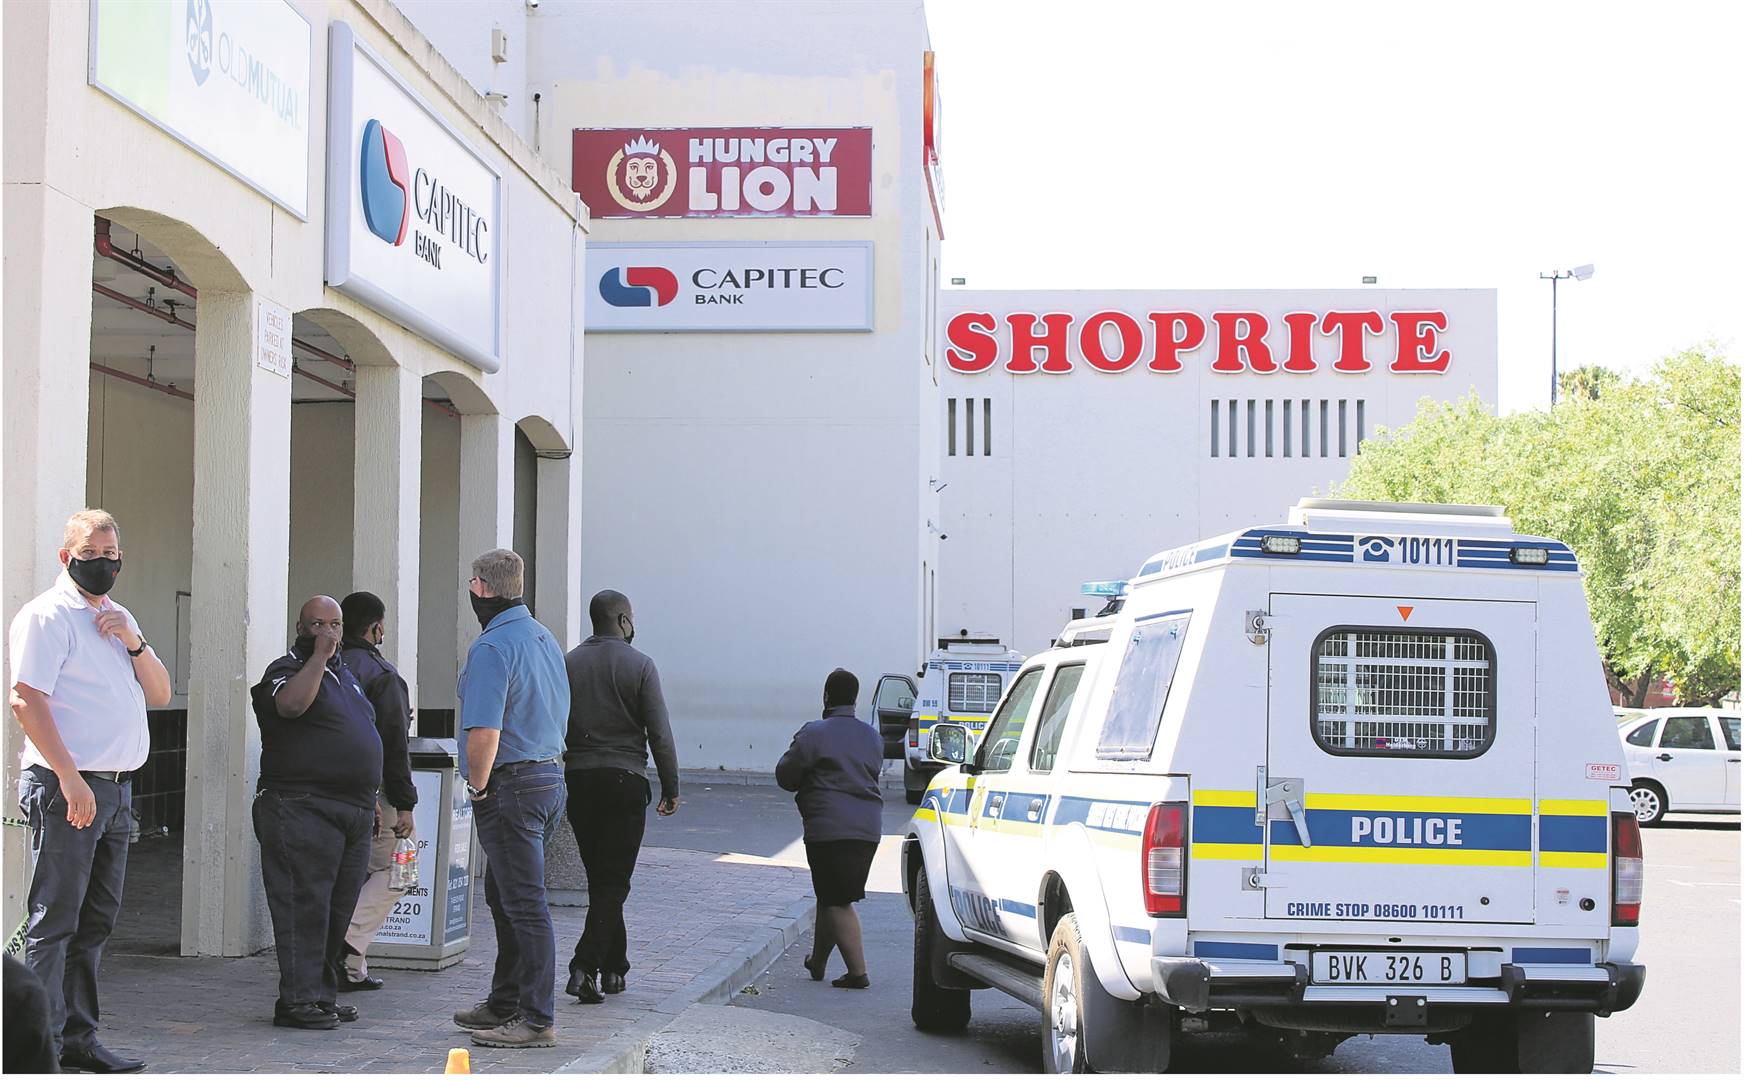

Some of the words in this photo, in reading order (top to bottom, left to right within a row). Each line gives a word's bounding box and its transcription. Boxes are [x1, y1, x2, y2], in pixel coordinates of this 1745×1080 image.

[688, 138, 838, 163] HUNGRY
[688, 166, 838, 211] LION
[414, 167, 488, 264] CAPITEC
[415, 229, 441, 270] BANK
[692, 267, 844, 289] CAPITEC
[694, 294, 744, 304] BANK
[945, 310, 1453, 374] SHOPRITE
[1163, 547, 1195, 571] POLICE
[1399, 537, 1454, 565] 10111
[959, 721, 987, 730] POLIC
[1351, 816, 1463, 845] POLICE
[418, 840, 429, 849] OF
[404, 887, 429, 897] MENTS
[386, 916, 411, 924] TRAND
[954, 889, 1007, 938] POLICE
[1287, 902, 1331, 916] CRIME
[1335, 903, 1369, 918] STOP
[1373, 904, 1417, 918] 08600
[1421, 905, 1464, 919] 10111
[1329, 956, 1368, 981] BVK
[1385, 956, 1424, 981] 326
[1440, 956, 1452, 981] B
